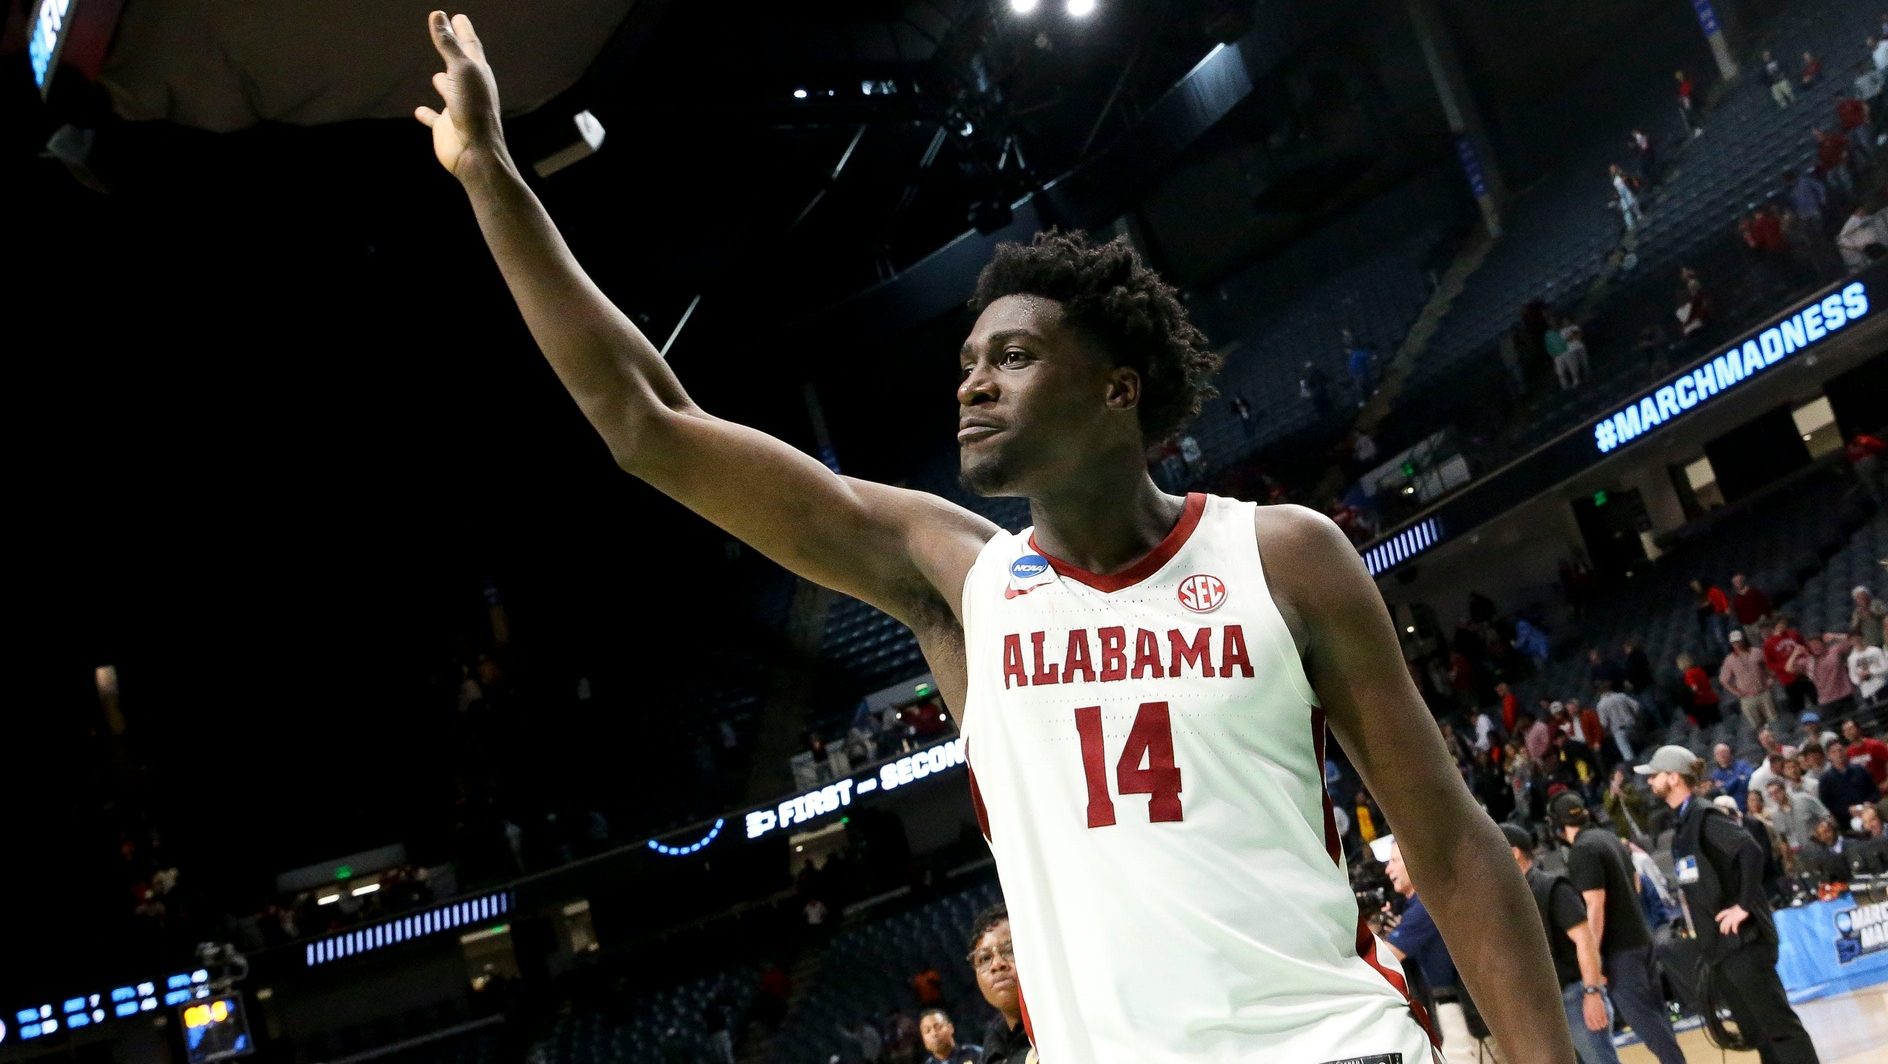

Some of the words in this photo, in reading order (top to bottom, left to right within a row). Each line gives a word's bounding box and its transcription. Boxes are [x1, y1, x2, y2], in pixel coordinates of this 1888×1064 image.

[1594, 282, 1868, 452] #MARCHMADNESS
[1013, 563, 1045, 573] NCAA
[1180, 575, 1224, 610] SEC
[1004, 624, 1255, 690] ALABAMA
[1074, 701, 1184, 828] 14
[778, 778, 853, 828] FIRST
